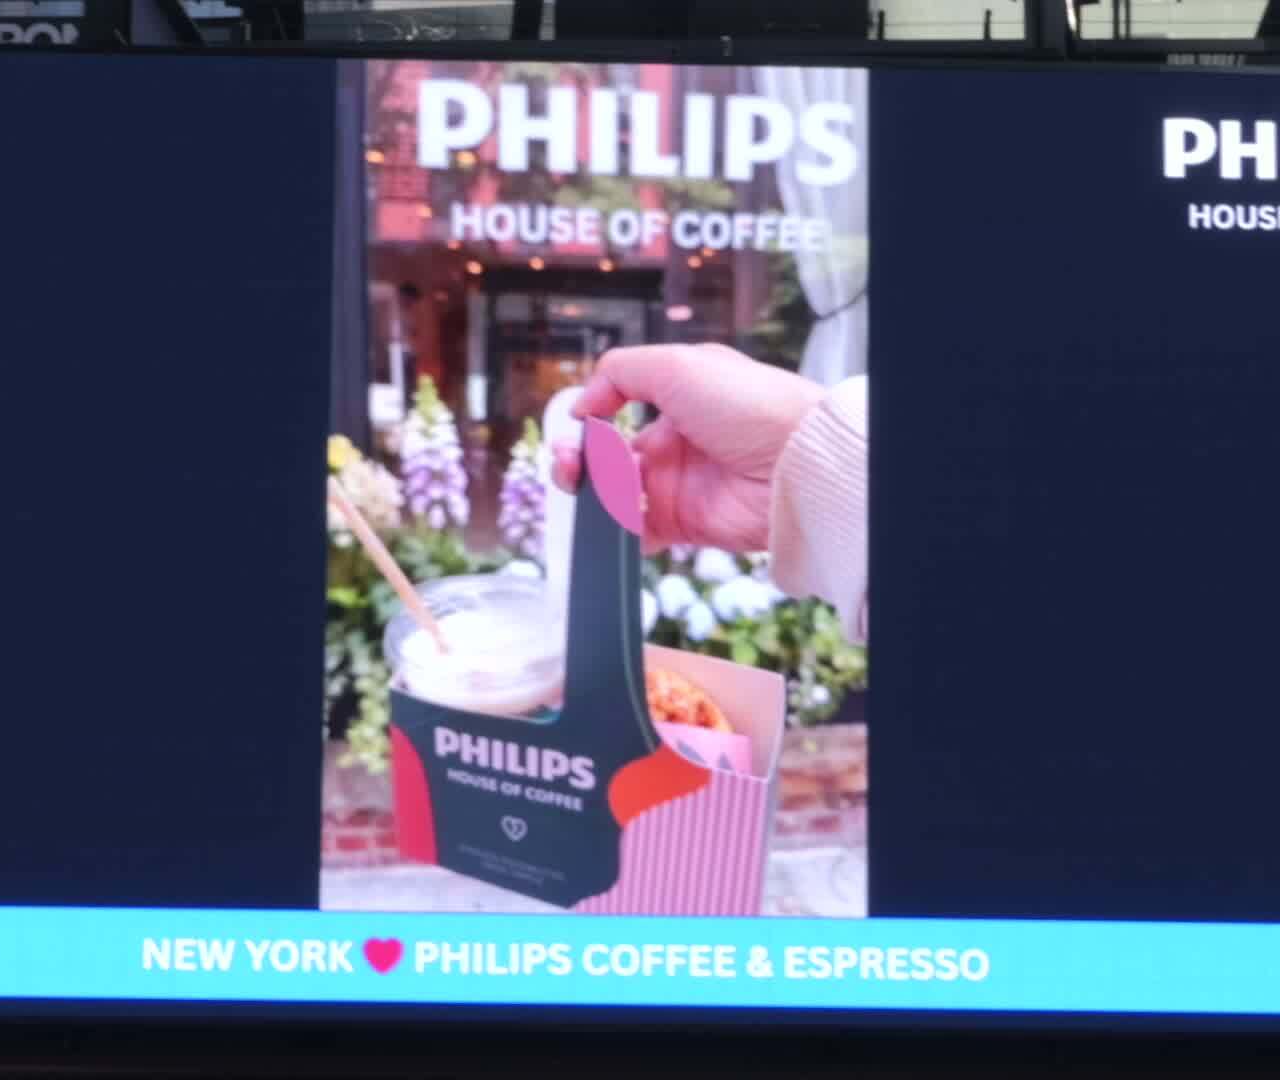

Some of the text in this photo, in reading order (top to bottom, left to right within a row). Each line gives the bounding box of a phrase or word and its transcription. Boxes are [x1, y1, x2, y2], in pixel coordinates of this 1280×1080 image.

[417, 79, 858, 186] PHILIPS
[451, 203, 830, 252] HOUSE OF COFFEE
[434, 726, 597, 790] PHILIPS
[447, 769, 584, 812] HOUSE OF COFFEE
[141, 937, 991, 982] NEW YORK PHILIPS COFFEE & ESPRESSO
